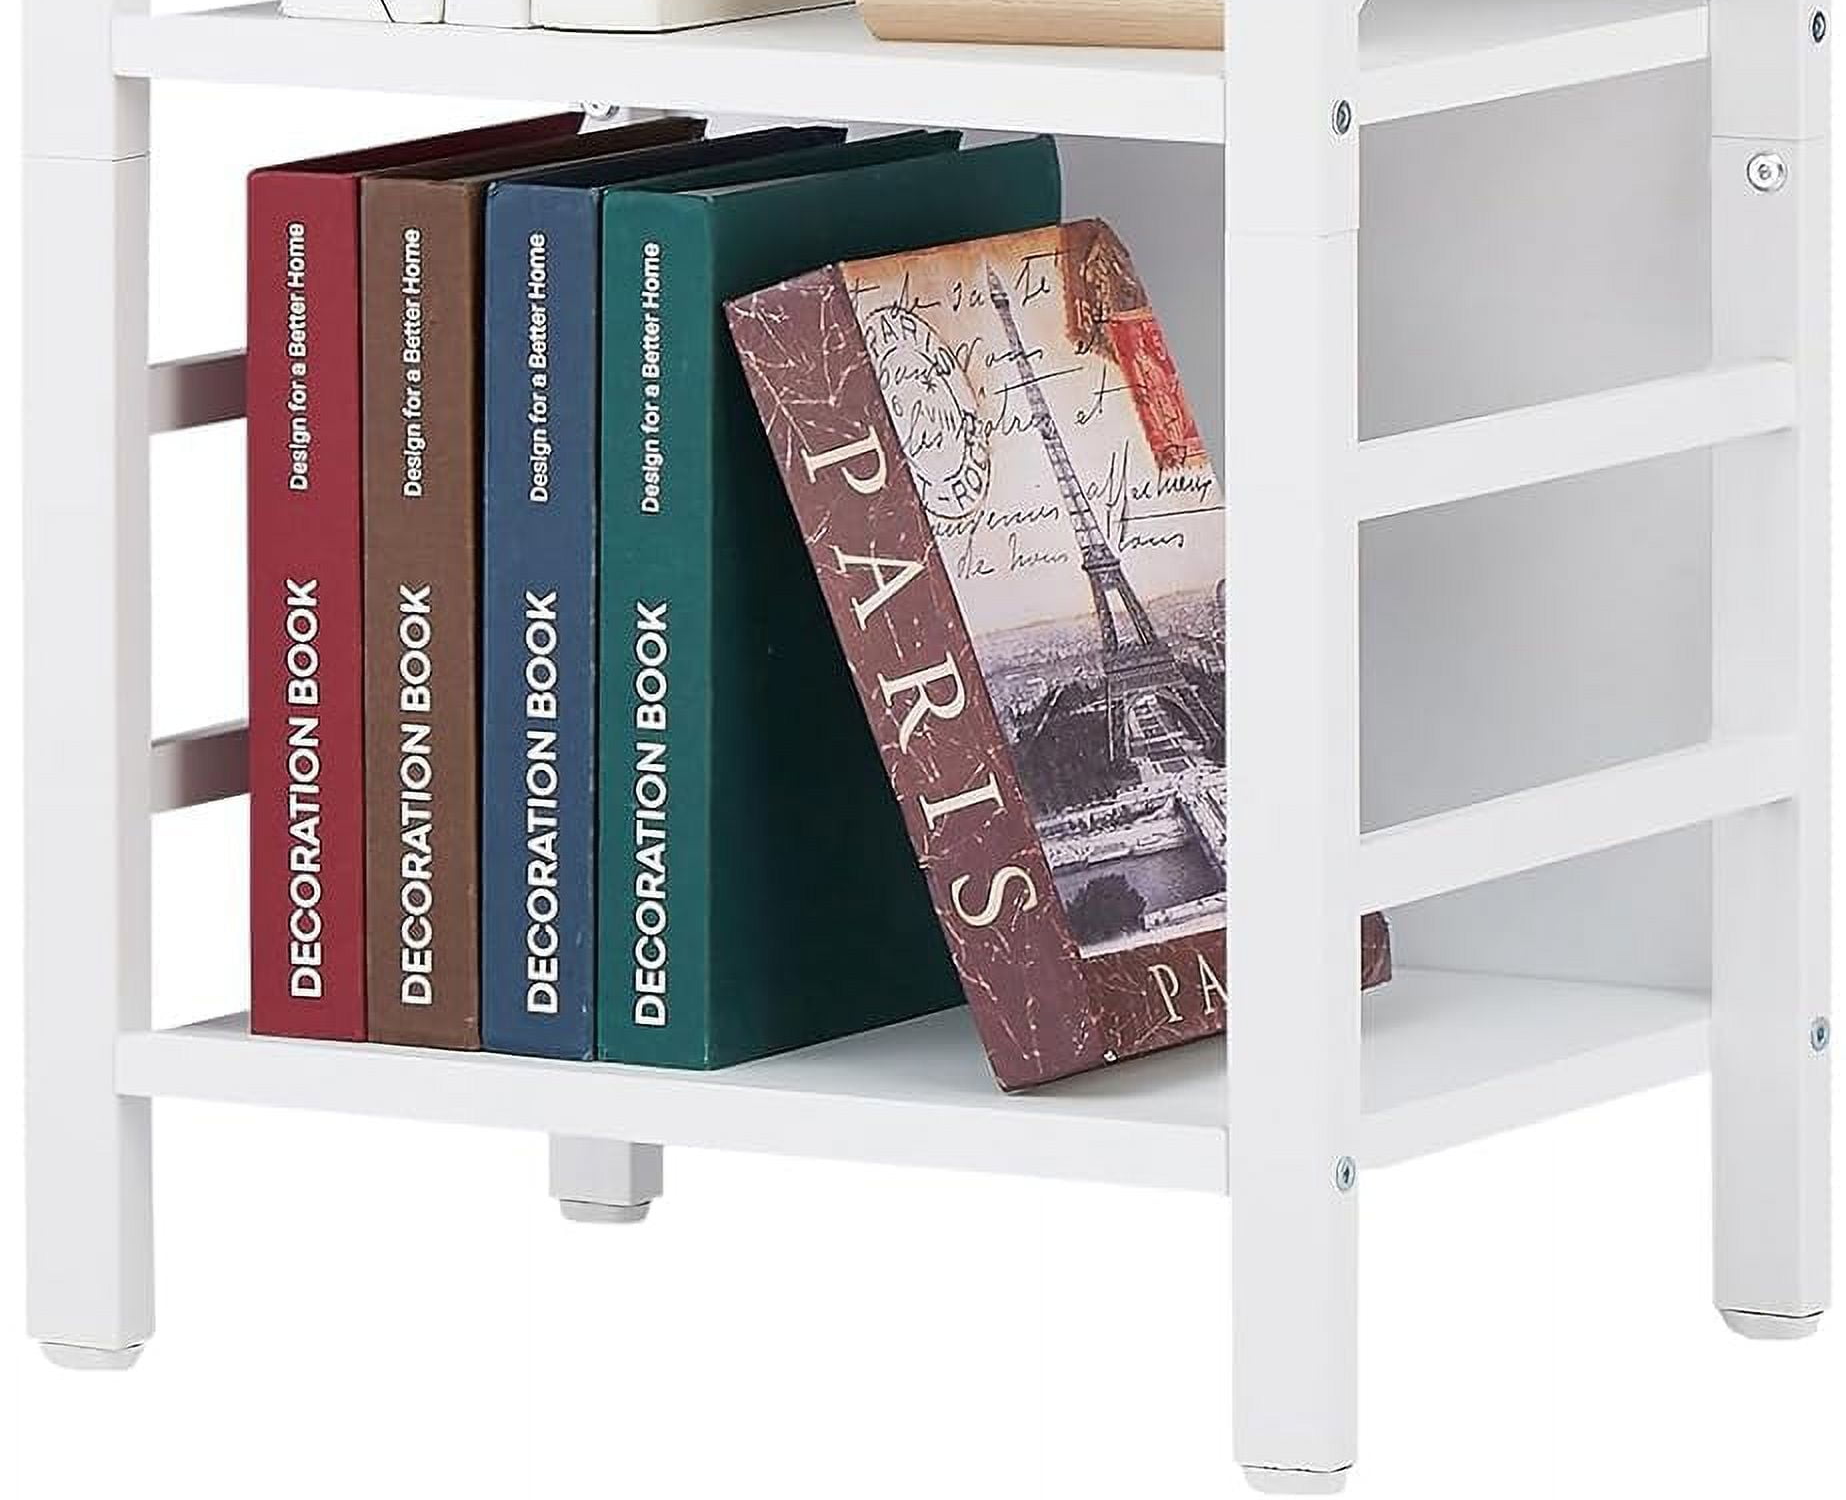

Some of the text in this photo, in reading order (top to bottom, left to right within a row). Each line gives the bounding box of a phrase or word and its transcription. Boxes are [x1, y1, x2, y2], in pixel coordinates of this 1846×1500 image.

[287, 223, 311, 490] Design for a Better Home
[402, 229, 426, 497] Design for a Better Home
[527, 233, 552, 502] Design for a Better Home
[640, 242, 664, 513] Design for a Better Home
[286, 578, 322, 998] DECORATION BOOK
[399, 584, 433, 1005] DECORATION BOOK
[525, 590, 558, 1014] DECORATION BOOK
[635, 601, 667, 1026] DECORATION BOOK
[800, 424, 1039, 928] PARIS
